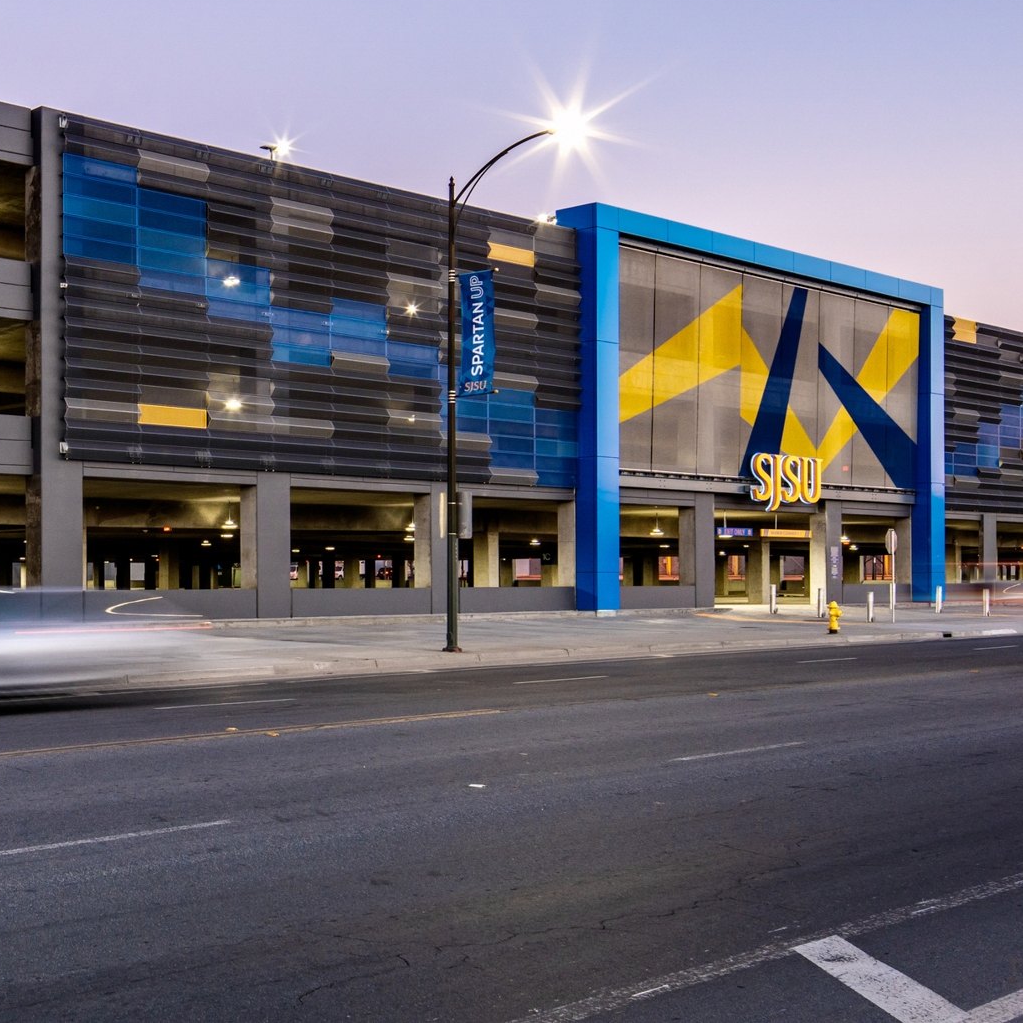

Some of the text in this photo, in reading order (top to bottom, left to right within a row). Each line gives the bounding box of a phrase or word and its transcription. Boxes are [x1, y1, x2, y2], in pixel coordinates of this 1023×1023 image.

[469, 275, 485, 376] SPARTAN UP
[464, 380, 487, 392] SJSU
[750, 452, 824, 512] SJSU
